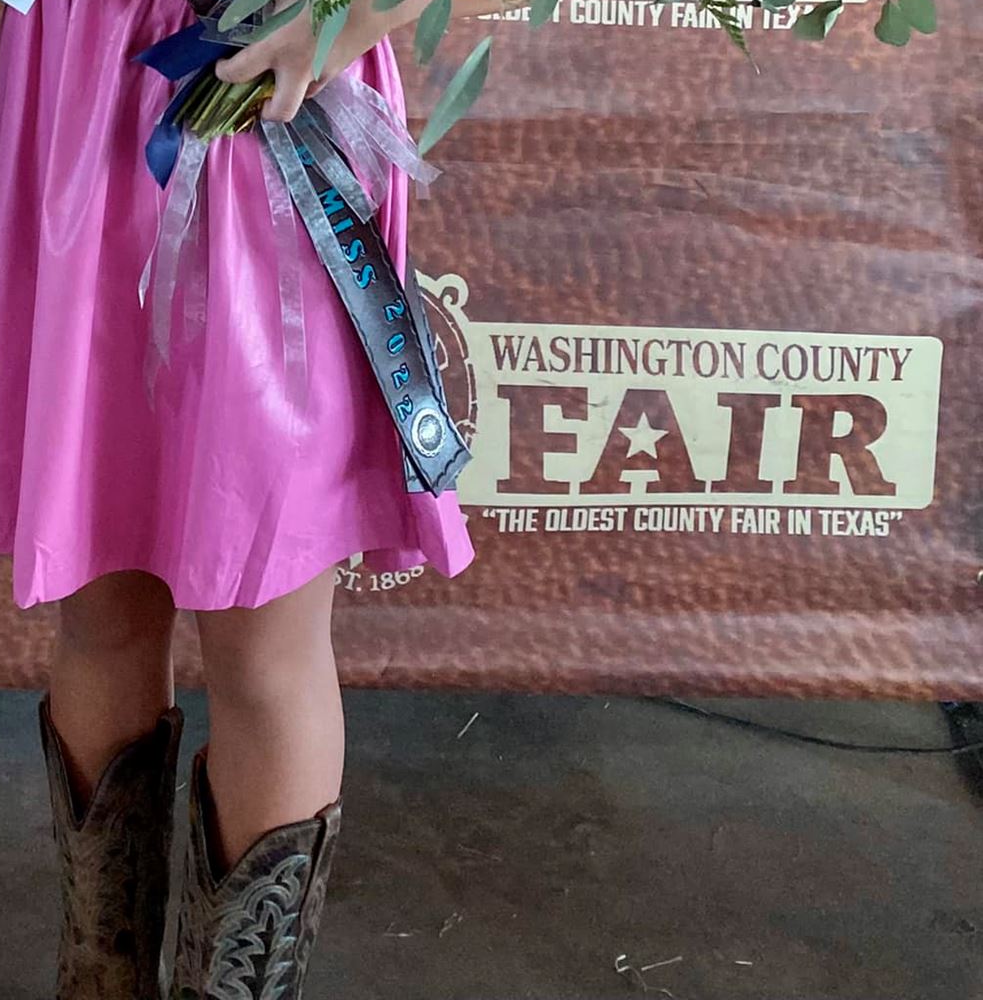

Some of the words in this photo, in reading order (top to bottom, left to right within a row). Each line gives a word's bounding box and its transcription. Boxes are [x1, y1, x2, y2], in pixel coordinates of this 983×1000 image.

[382, 299, 415, 424] 2022
[489, 333, 746, 380] WASHINGTON
[756, 342, 913, 383] COUNTY
[496, 383, 897, 497] FAIR
[544, 507, 628, 532] OLDEST
[633, 506, 725, 533] COUNTY
[731, 507, 781, 535] FAIR
[787, 509, 812, 536] IN
